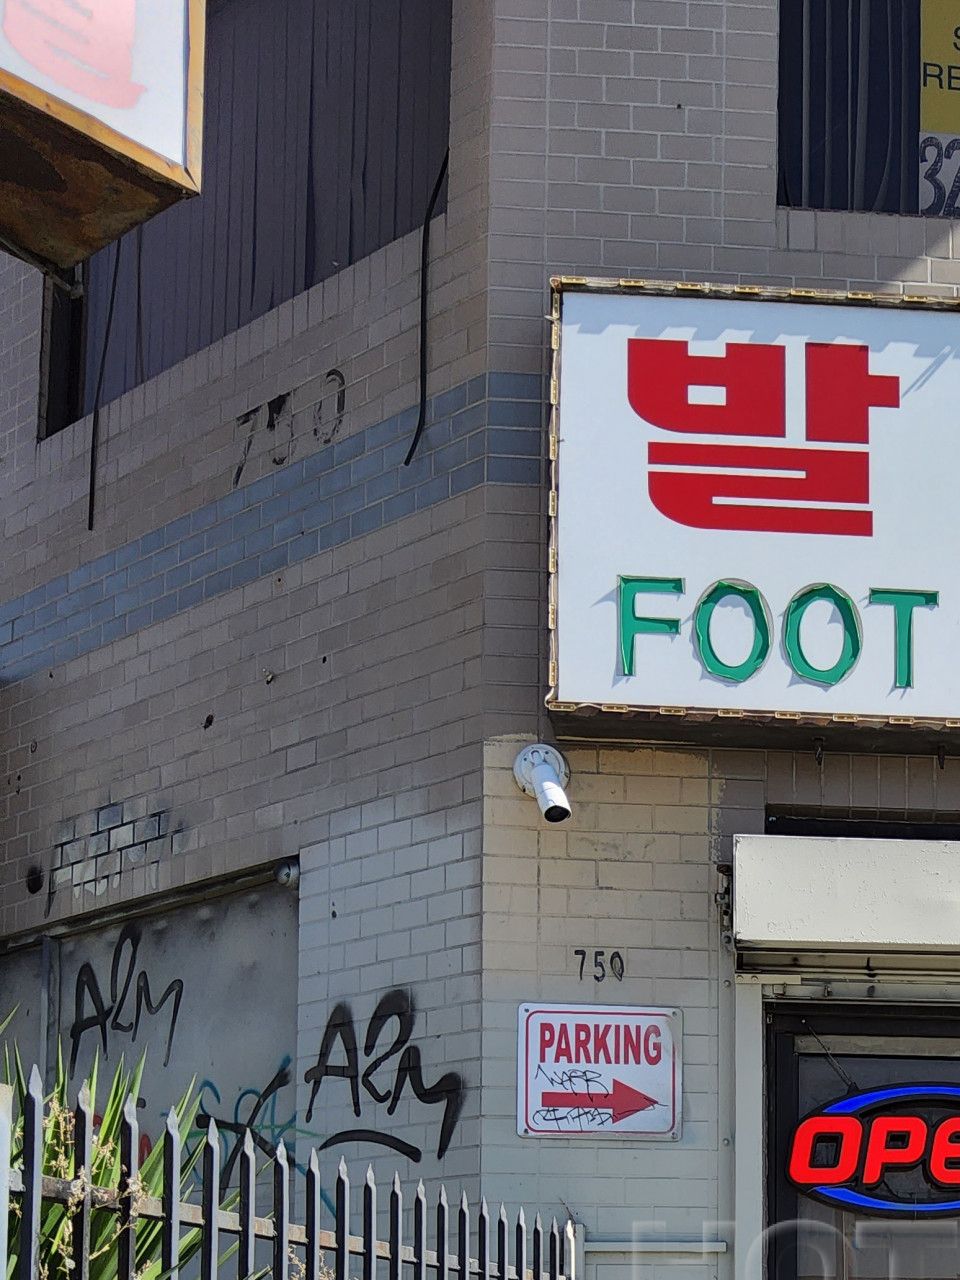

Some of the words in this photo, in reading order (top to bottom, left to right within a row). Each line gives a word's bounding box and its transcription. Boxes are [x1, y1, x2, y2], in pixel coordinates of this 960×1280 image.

[616, 574, 940, 690] FOOT
[574, 949, 625, 982] 750
[539, 1022, 662, 1066] PARKING
